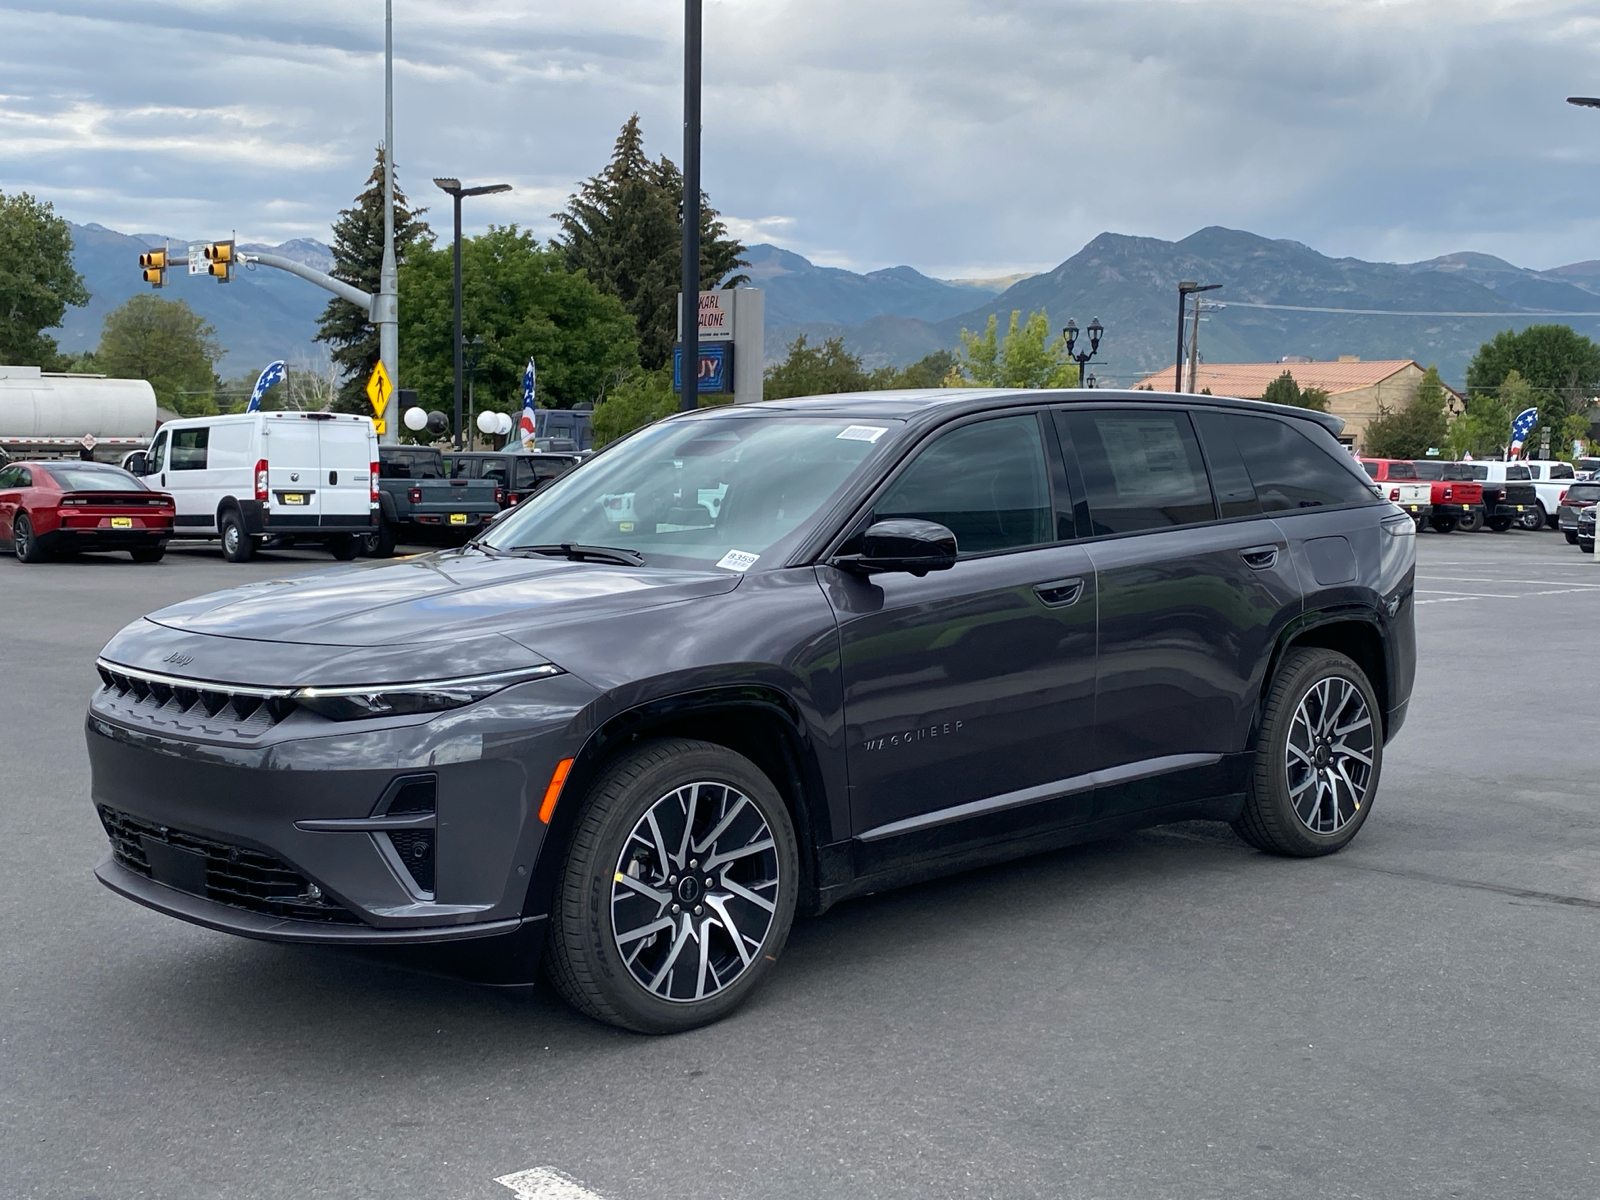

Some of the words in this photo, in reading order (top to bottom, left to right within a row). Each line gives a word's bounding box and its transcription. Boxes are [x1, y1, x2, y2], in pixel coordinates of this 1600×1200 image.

[698, 295, 719, 309] KARL
[698, 312, 725, 327] ALONE
[728, 553, 755, 563] 8359
[163, 652, 194, 667] Jeep
[590, 875, 615, 979] FALKEN
